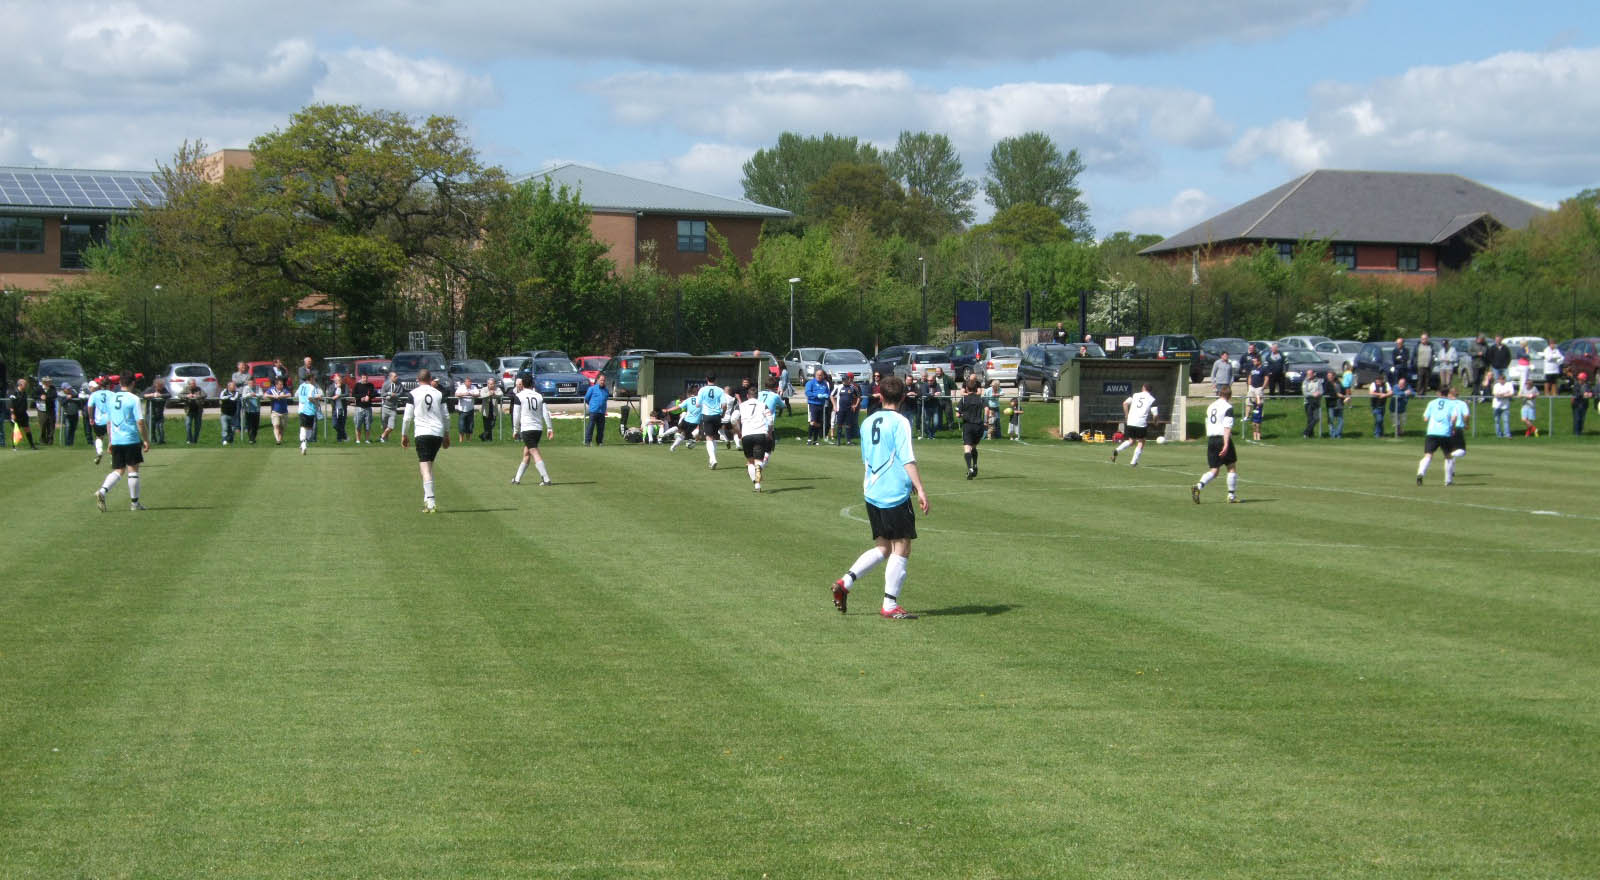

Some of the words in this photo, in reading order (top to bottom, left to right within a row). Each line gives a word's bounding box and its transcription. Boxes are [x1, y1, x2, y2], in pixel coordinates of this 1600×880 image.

[101, 393, 107, 403] 3
[708, 389, 714, 399] 4
[762, 394, 768, 403] 7
[115, 395, 123, 410] 5
[425, 394, 432, 410] 9
[526, 397, 538, 411] 10
[1137, 397, 1145, 408] 5
[1438, 400, 1445, 410] 9
[749, 403, 756, 416] 7
[1211, 409, 1217, 424] 8
[871, 417, 883, 445] 6
